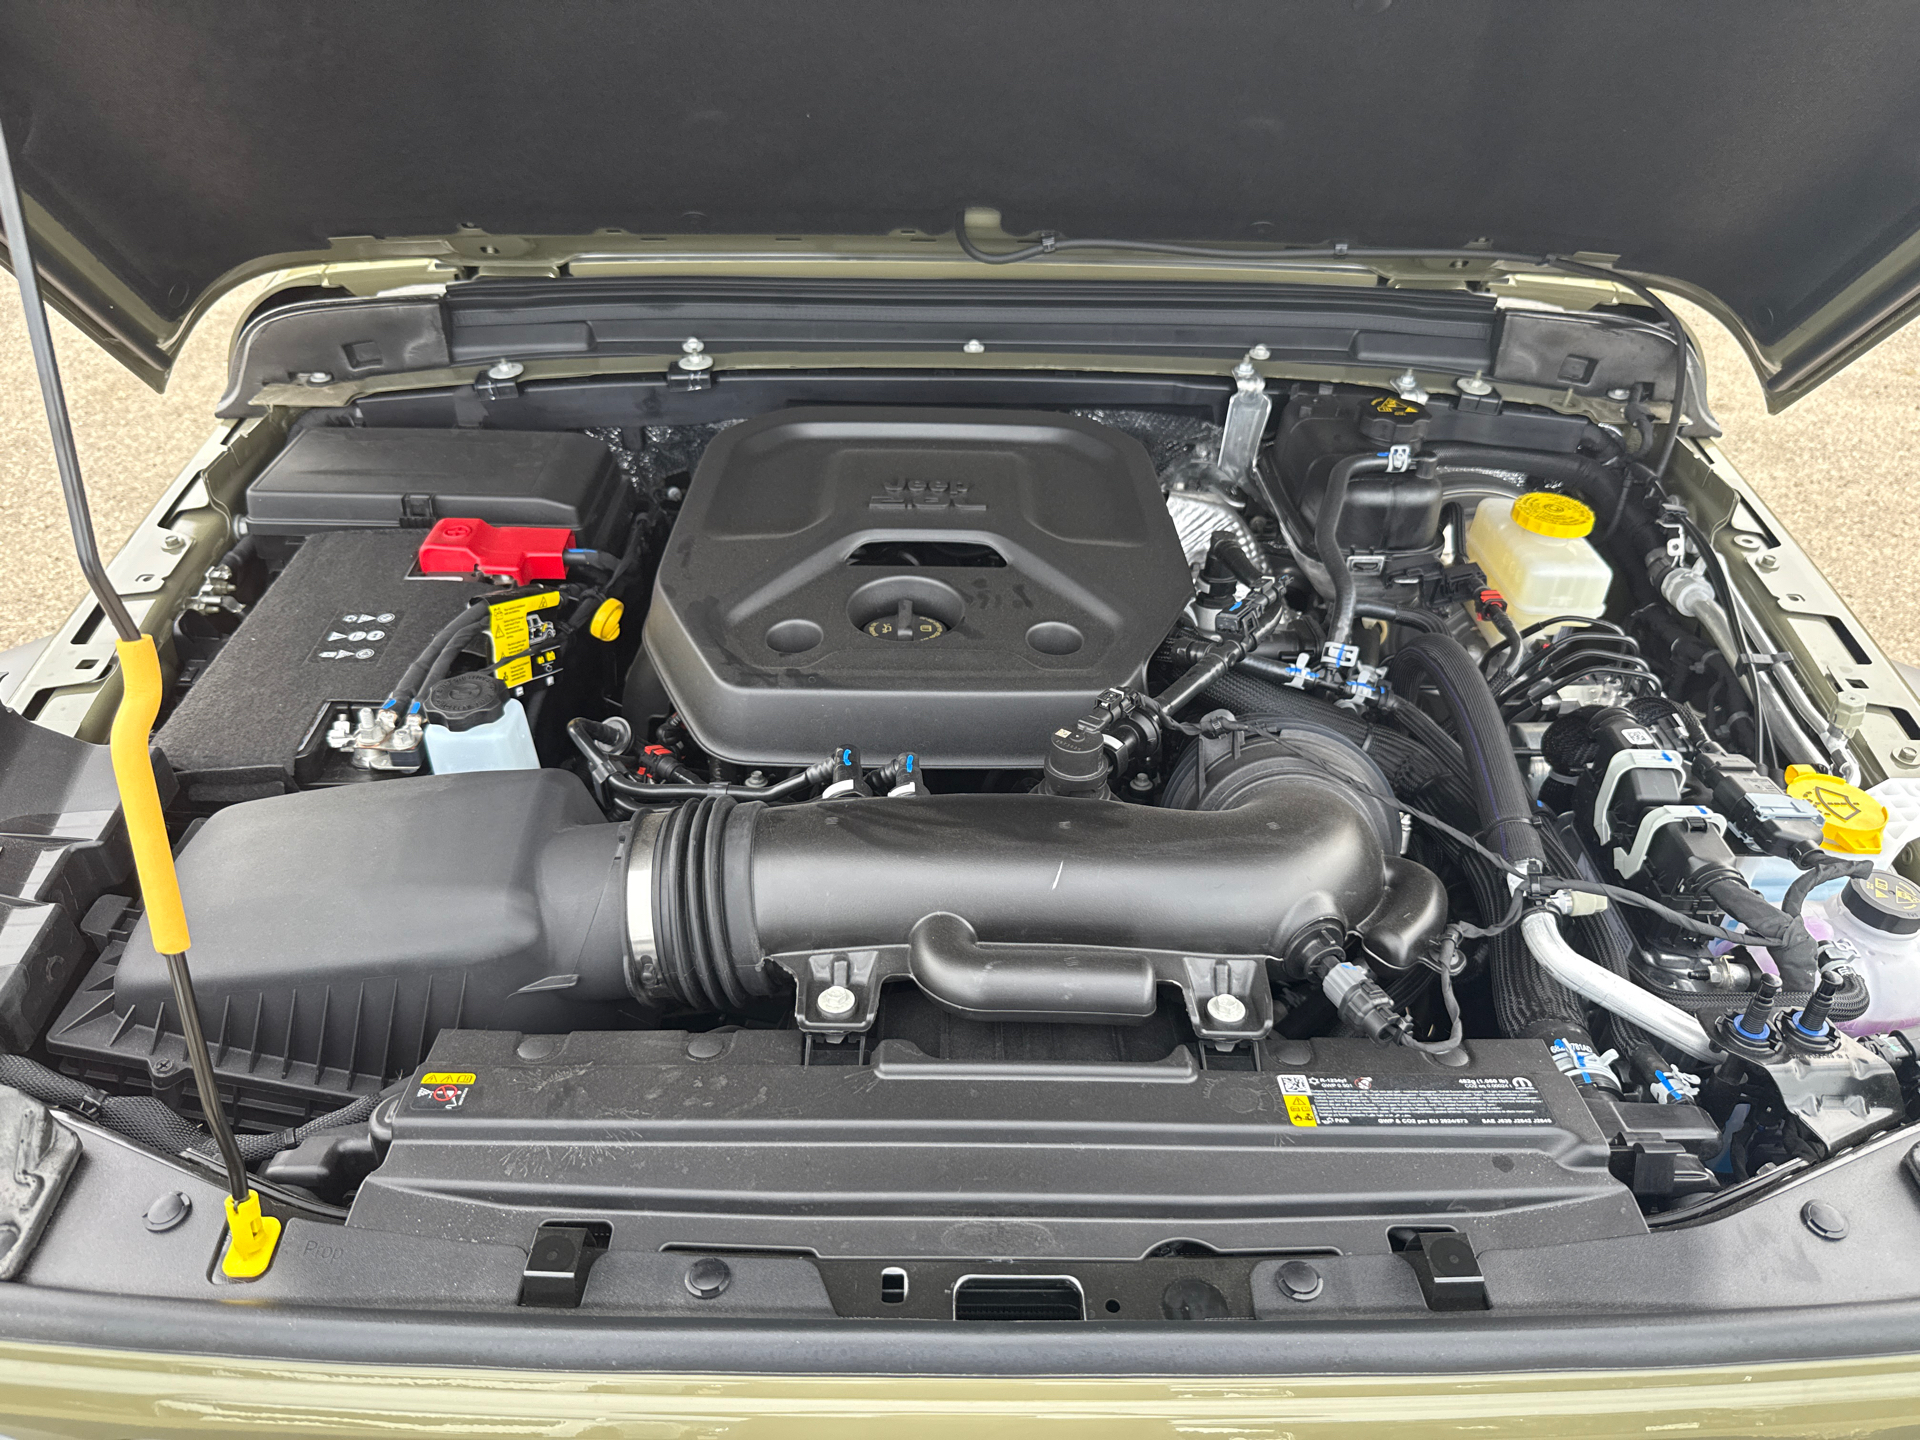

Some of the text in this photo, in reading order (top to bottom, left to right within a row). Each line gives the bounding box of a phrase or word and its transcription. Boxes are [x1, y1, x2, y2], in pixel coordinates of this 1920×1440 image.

[883, 477, 969, 496] Jeep
[868, 495, 987, 511] 2.0L
[303, 1240, 344, 1262] Prop
